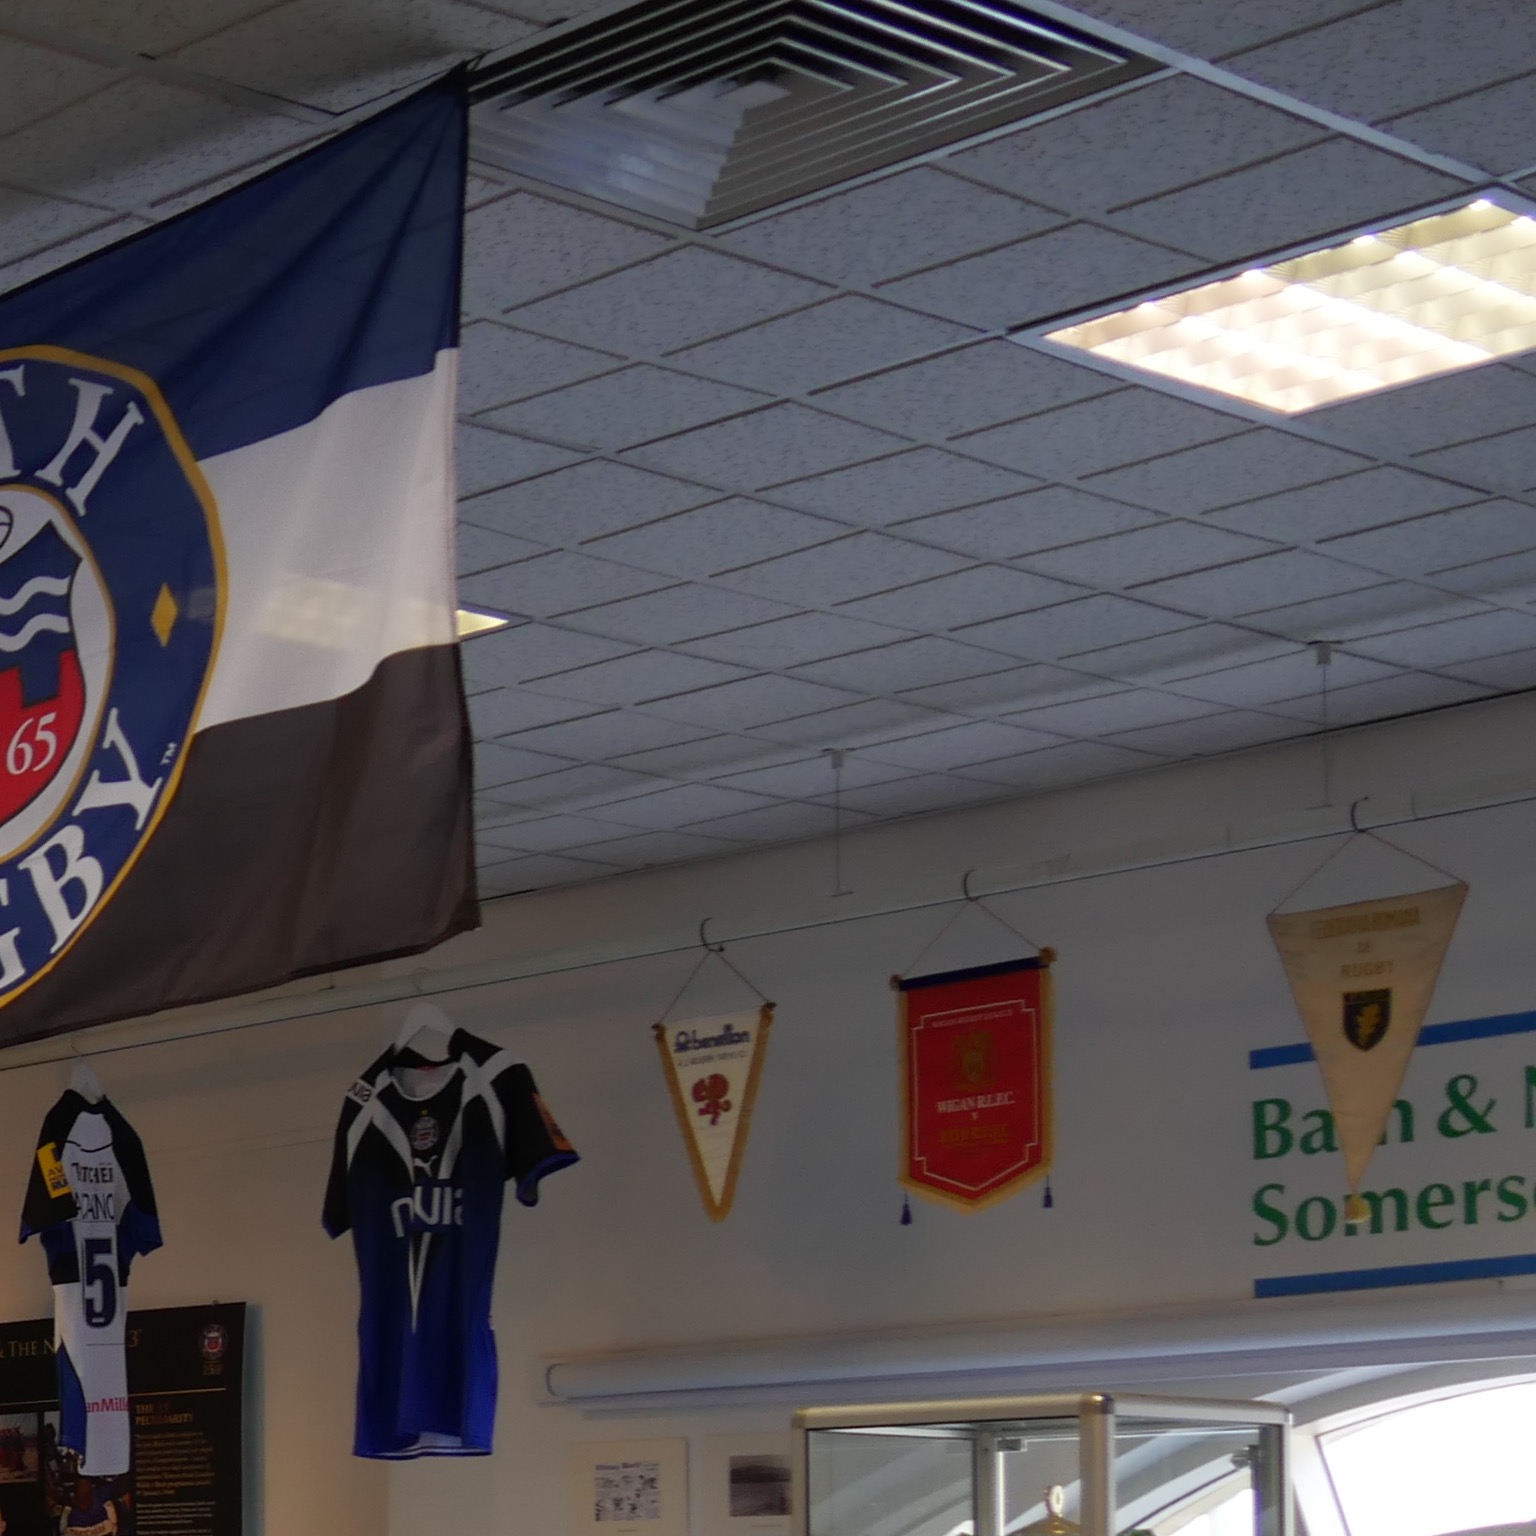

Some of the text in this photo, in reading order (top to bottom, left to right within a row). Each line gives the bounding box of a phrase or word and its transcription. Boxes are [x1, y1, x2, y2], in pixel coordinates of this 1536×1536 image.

[6, 712, 58, 775] 65
[1252, 1073, 1497, 1160] Bah &
[1252, 1175, 1536, 1247] Somers
[7, 1340, 39, 1358] THE
